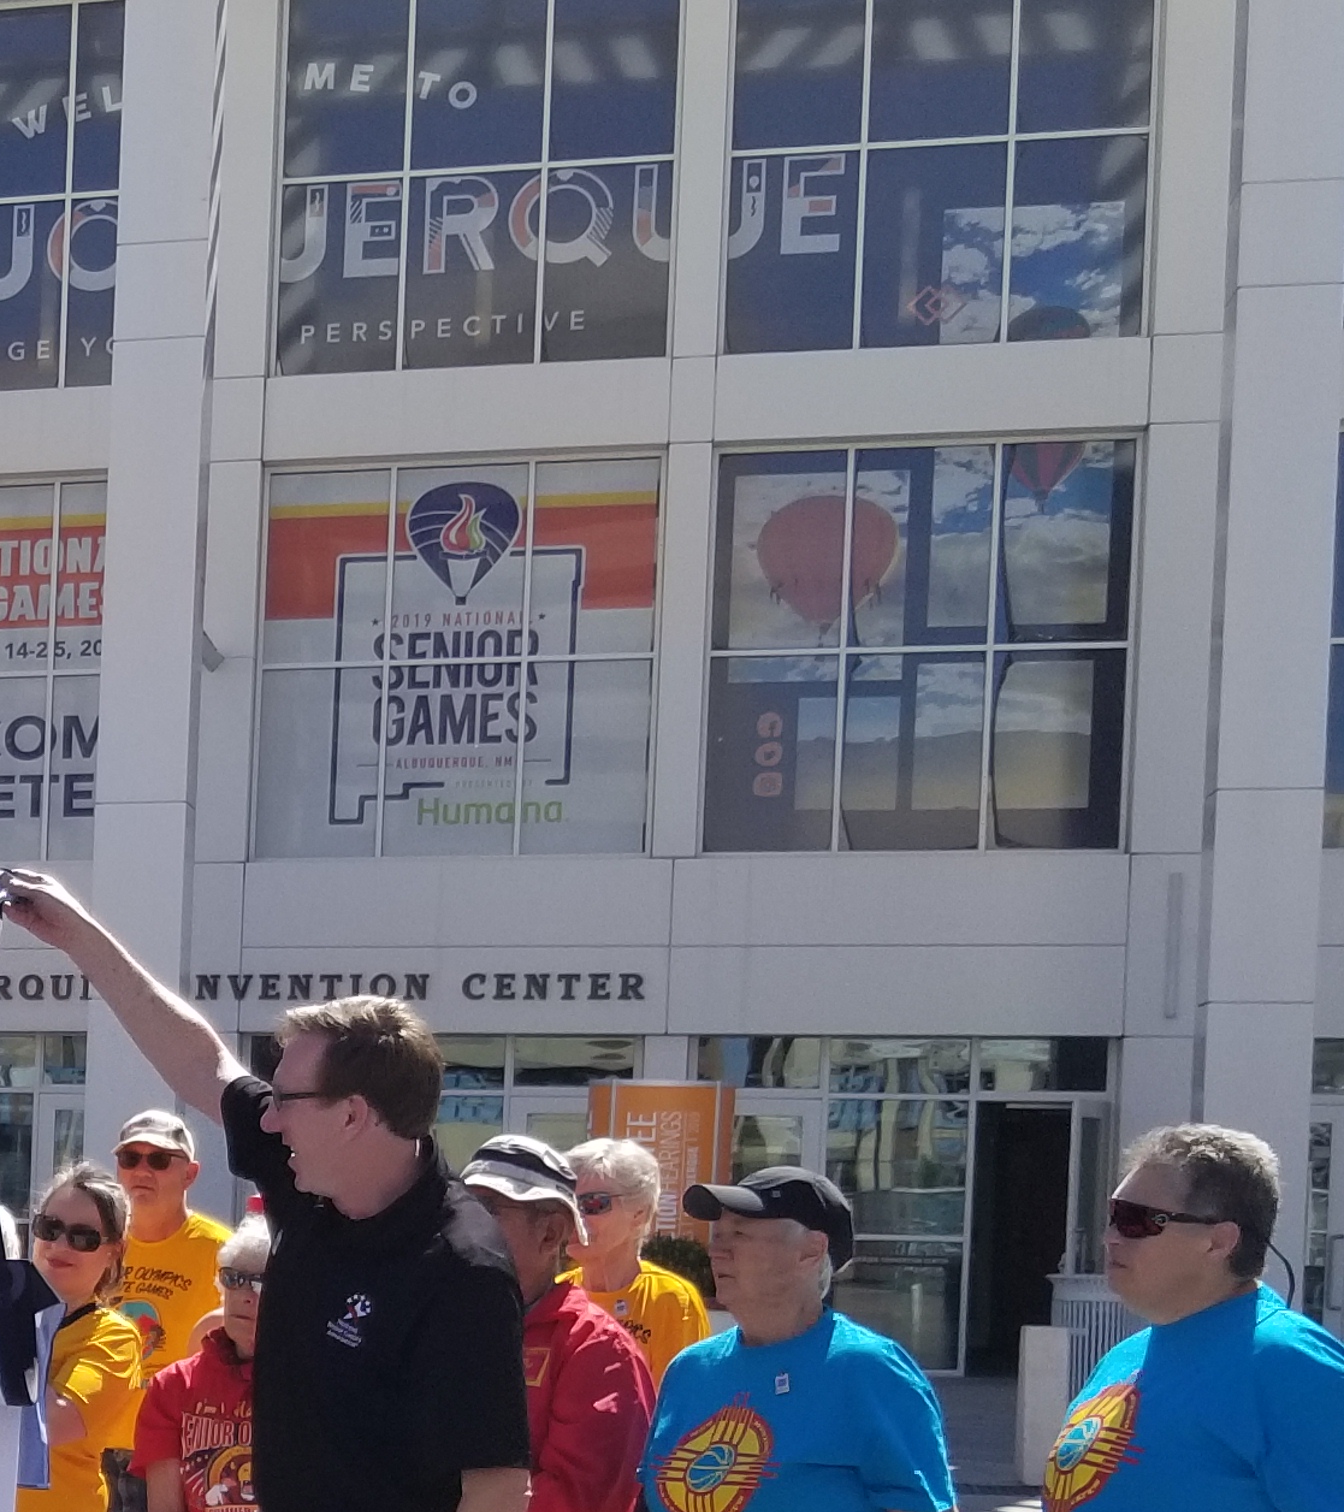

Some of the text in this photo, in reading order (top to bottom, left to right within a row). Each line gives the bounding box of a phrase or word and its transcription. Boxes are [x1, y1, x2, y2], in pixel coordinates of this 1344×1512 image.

[418, 71, 477, 109] TO
[300, 309, 587, 344] PERSPECTIVE
[391, 613, 432, 629] 2019
[4, 642, 73, 660] 14-25,
[371, 629, 540, 691] SENIOR
[372, 692, 538, 747] GAMES
[462, 973, 645, 1001] CENTER
